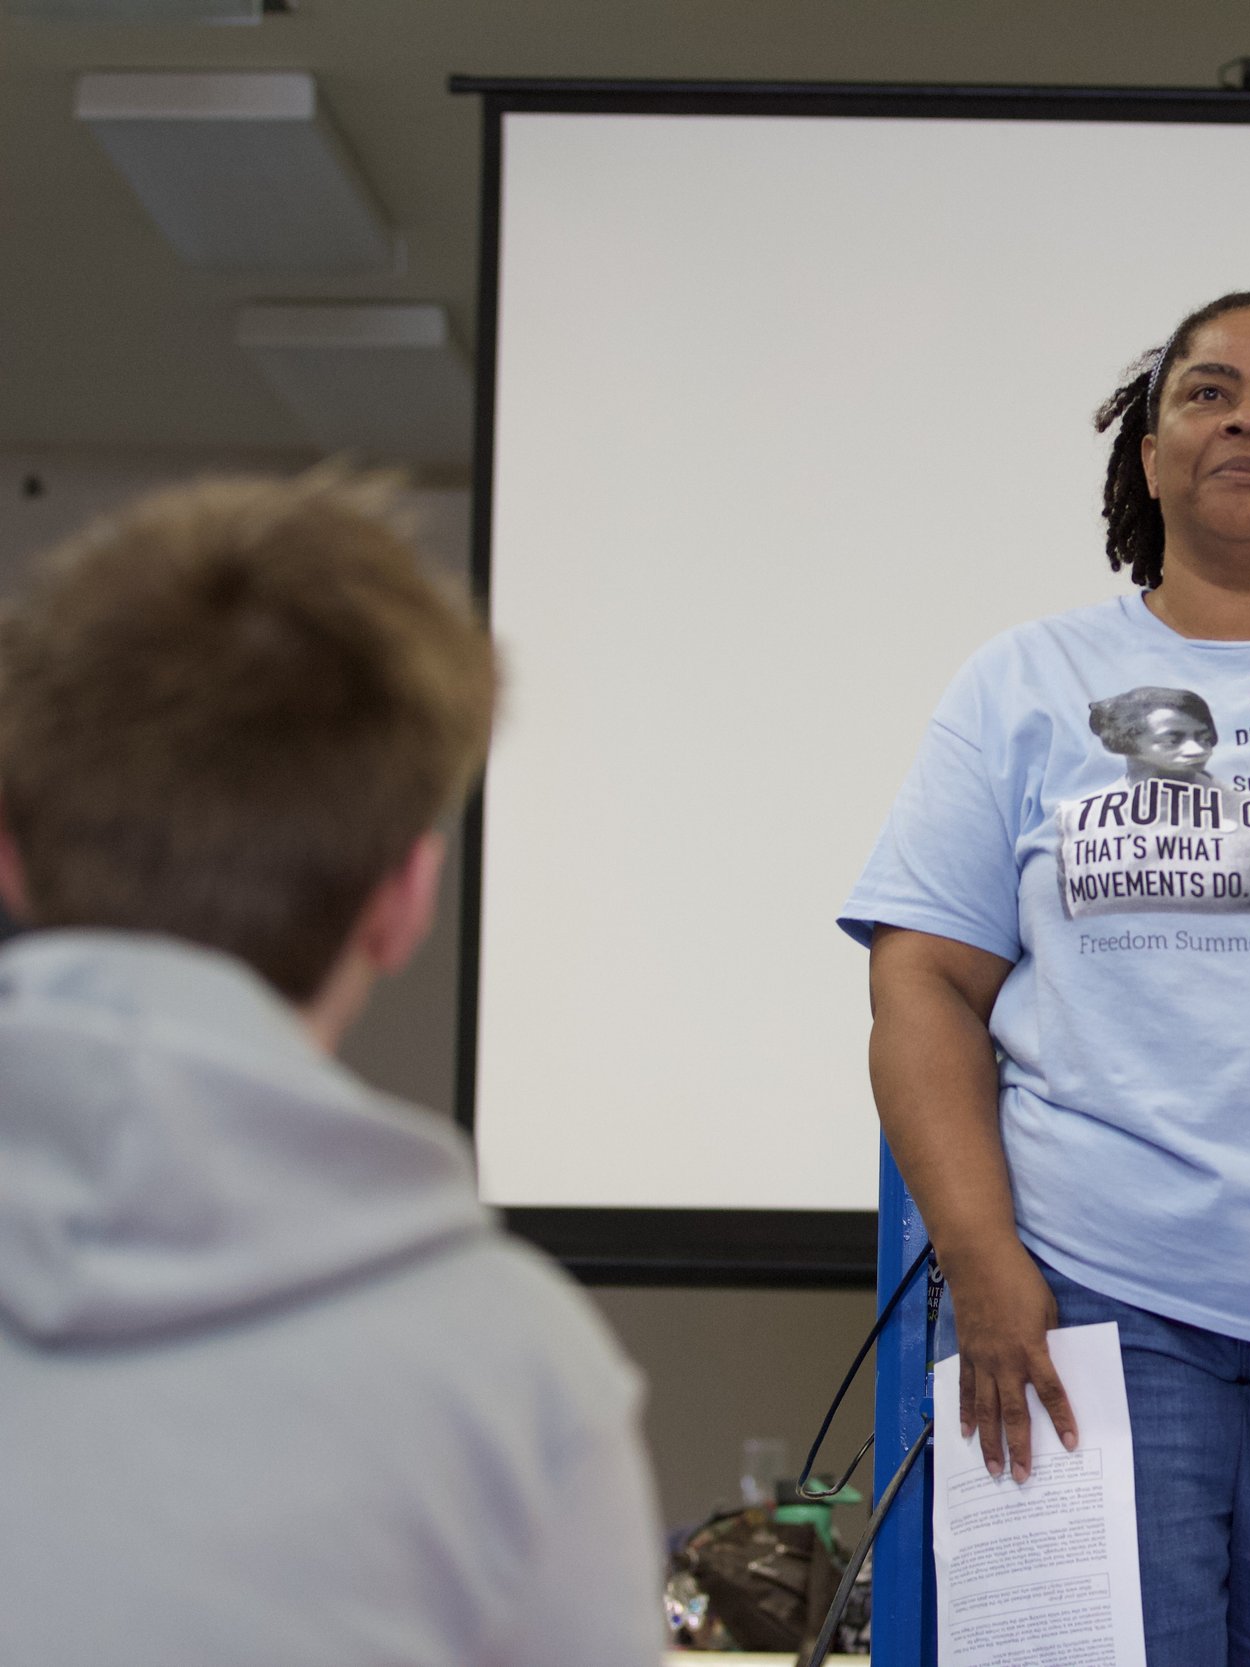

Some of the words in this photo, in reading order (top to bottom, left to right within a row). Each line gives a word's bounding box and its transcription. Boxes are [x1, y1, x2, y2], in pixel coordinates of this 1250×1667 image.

[1078, 779, 1221, 831] TRUTH
[1156, 836, 1223, 861] WHAT
[1069, 871, 1204, 902] MOVEMENTS
[1213, 872, 1249, 898] DO.
[1080, 929, 1168, 954] Freedom
